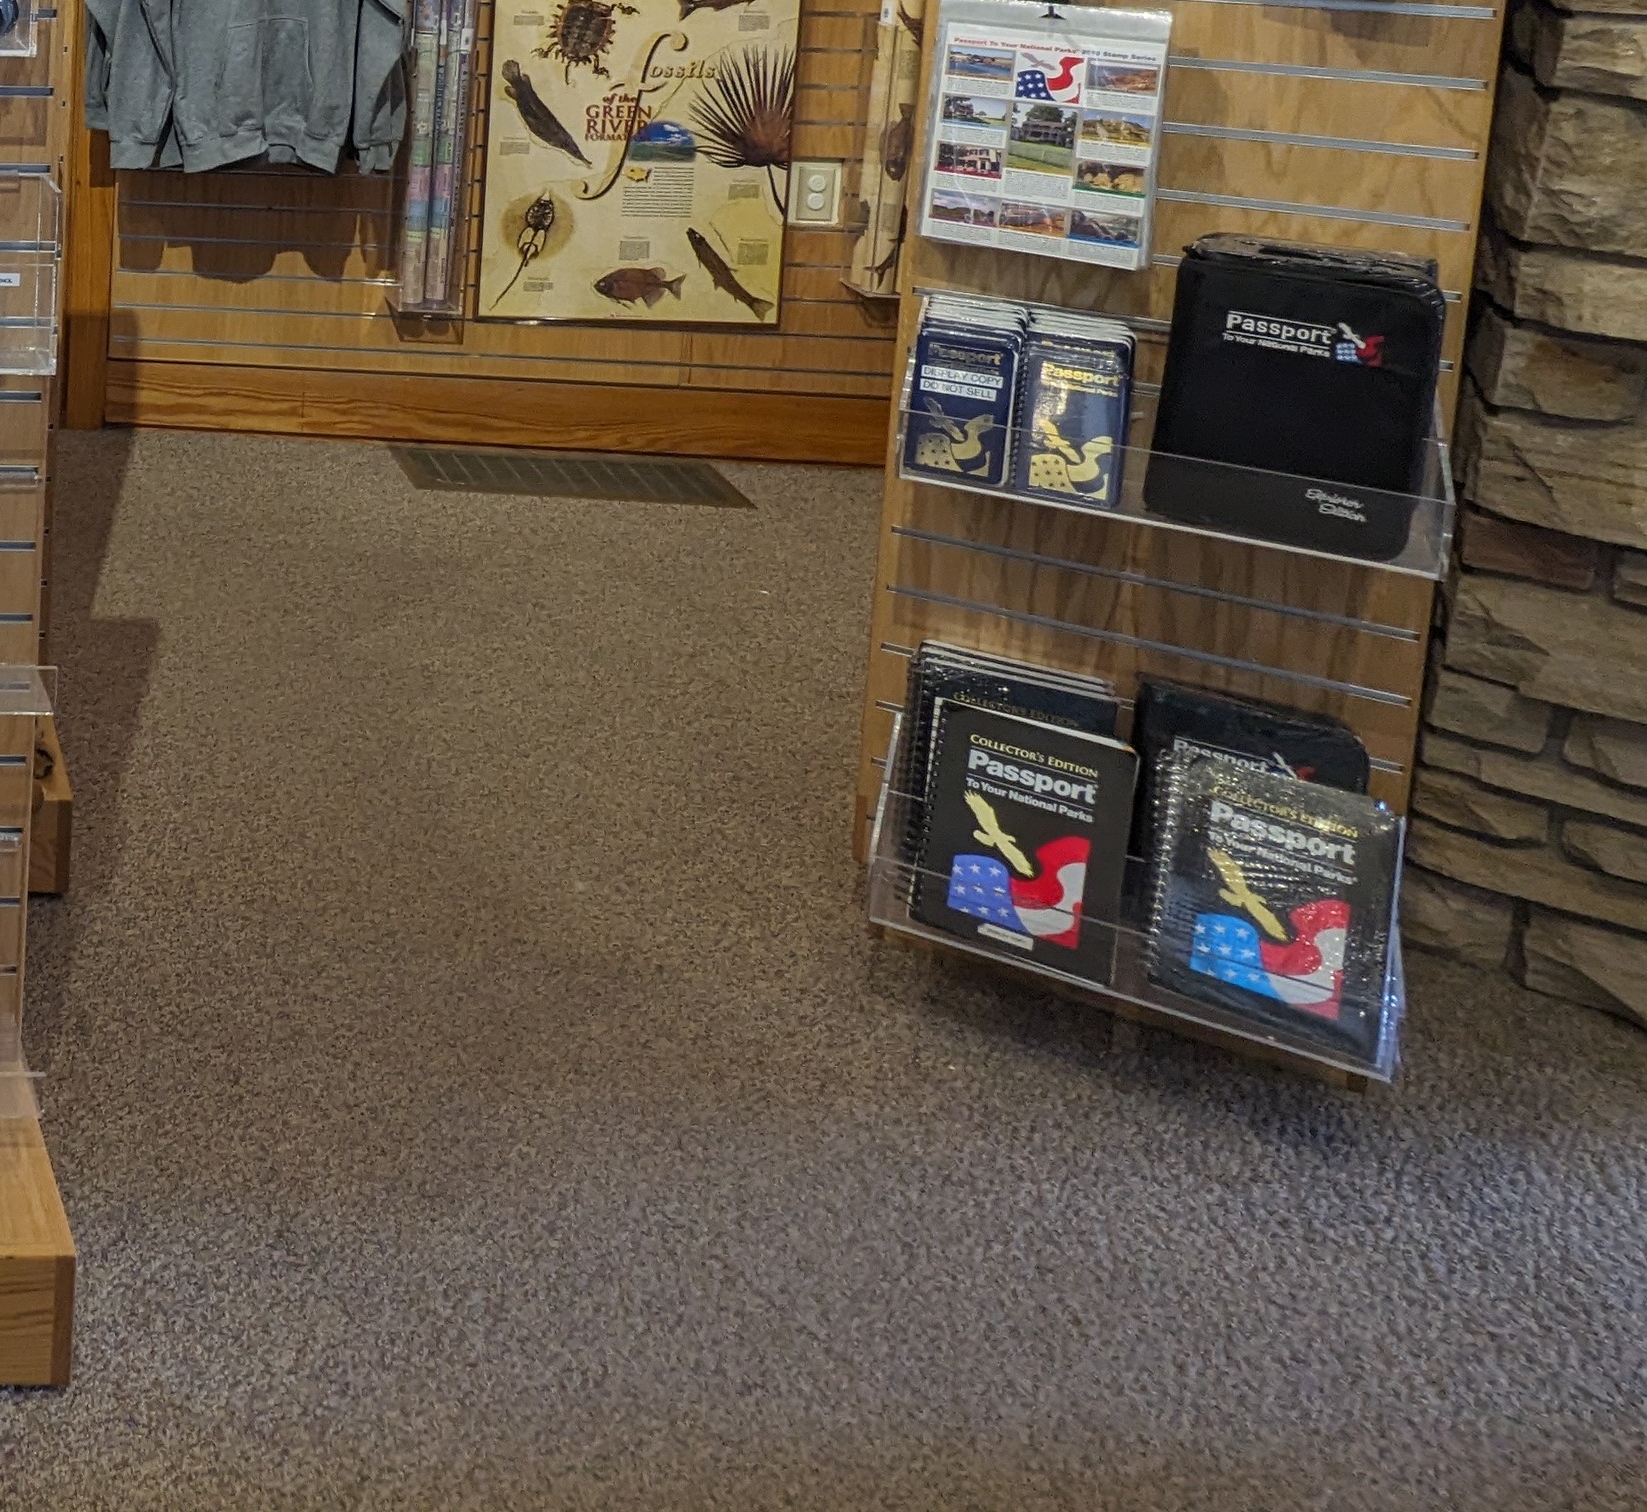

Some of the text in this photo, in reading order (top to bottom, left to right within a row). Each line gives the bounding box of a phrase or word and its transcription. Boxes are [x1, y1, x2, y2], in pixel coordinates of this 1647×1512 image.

[954, 37, 987, 46] Passport
[1020, 44, 1053, 52] National
[1103, 51, 1128, 60] Stamp
[1130, 54, 1157, 62] Series
[585, 105, 652, 119] GREEN
[602, 93, 617, 105] of
[1226, 313, 1332, 344] Passport
[1222, 333, 1330, 358] To Your National Parks
[922, 380, 994, 399] DO NOT SELL
[923, 368, 968, 382] DISPLAY
[970, 374, 1002, 387] COPY
[970, 734, 1098, 777] COLLECTOR'S EDITION
[968, 749, 1097, 805] Passport
[966, 776, 1093, 823] To Your National Parks
[1210, 800, 1356, 865] Passport
[1256, 846, 1312, 873] National
[1314, 865, 1356, 885] Parks
